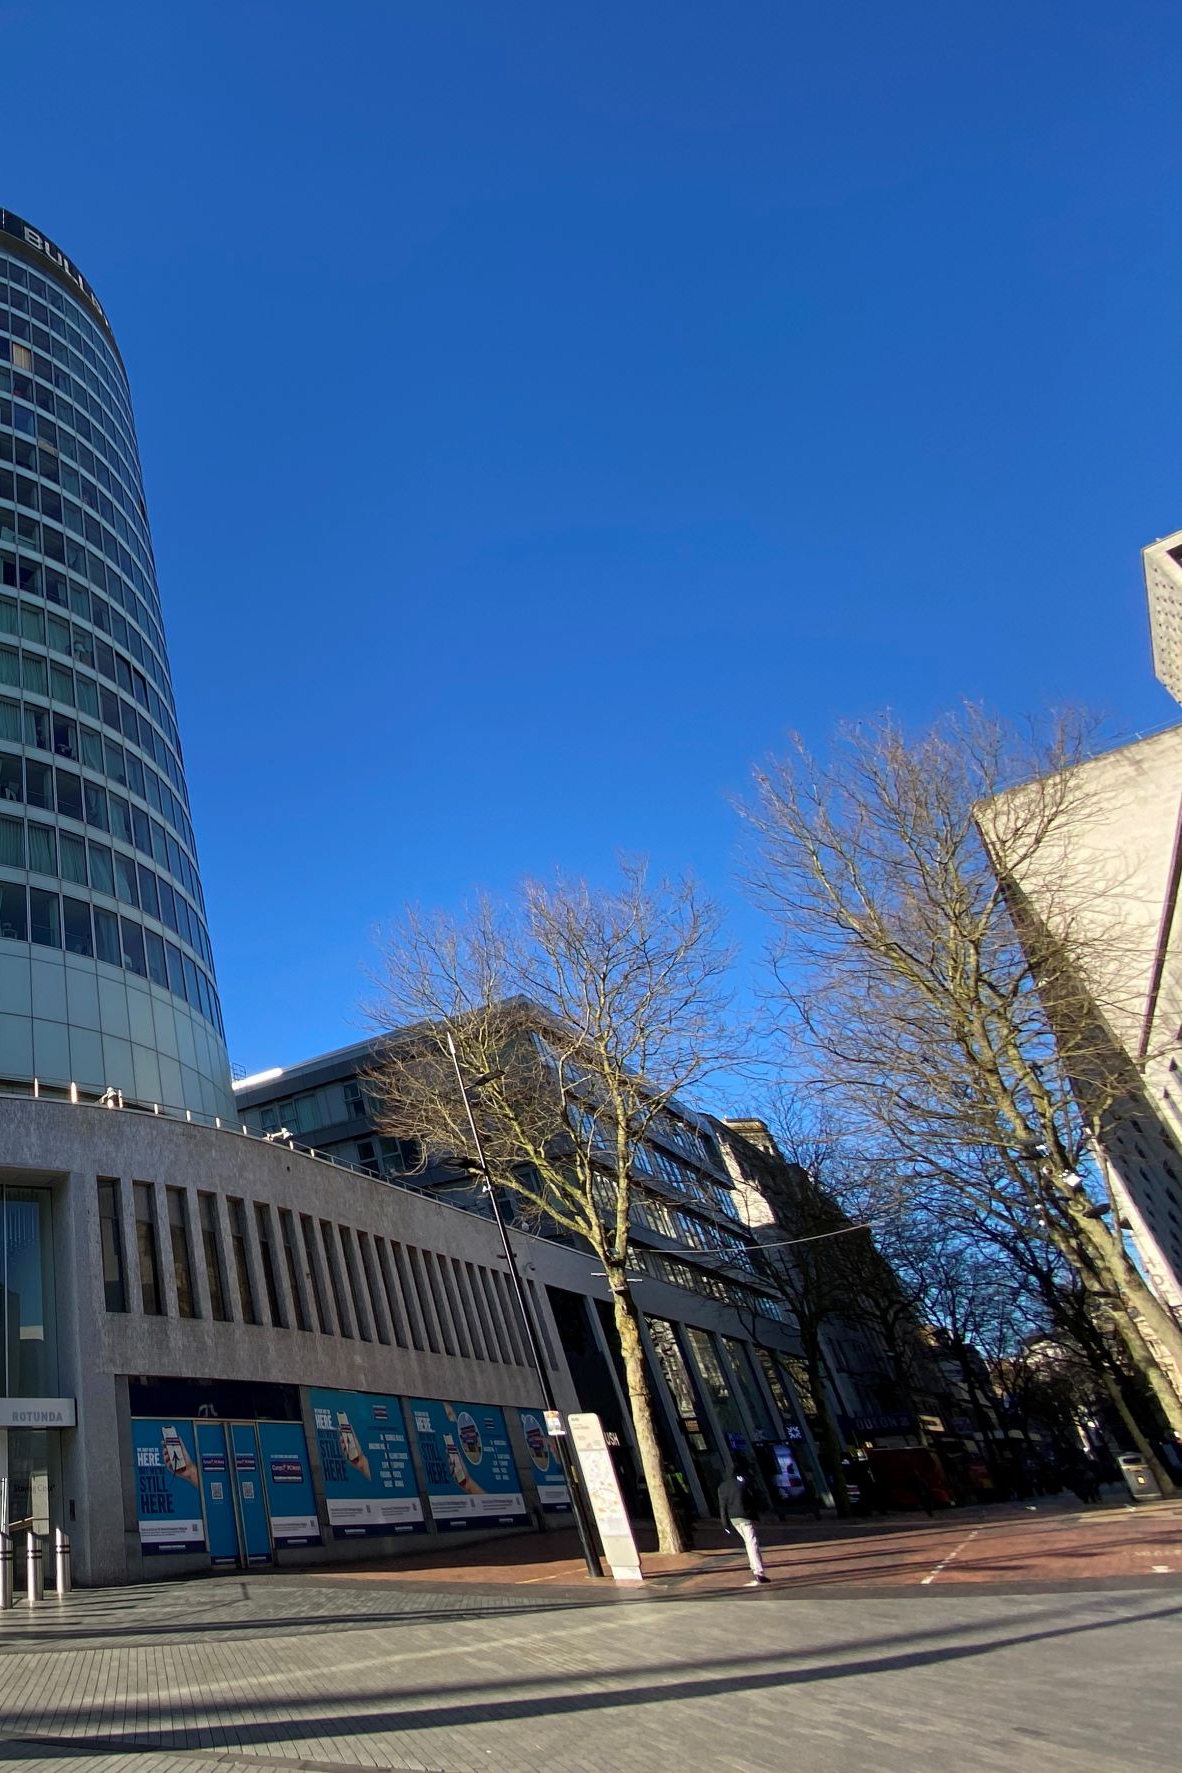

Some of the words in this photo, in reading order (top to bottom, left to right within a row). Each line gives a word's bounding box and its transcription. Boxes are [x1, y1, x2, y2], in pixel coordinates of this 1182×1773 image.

[12, 1411, 63, 1422] ROTUNDA
[855, 1416, 899, 1431] ODEON
[603, 1431, 621, 1447] USH
[320, 1440, 343, 1458] STILL
[323, 1459, 349, 1481] HERE
[140, 1476, 168, 1493] STILL
[141, 1494, 175, 1514] HERE
